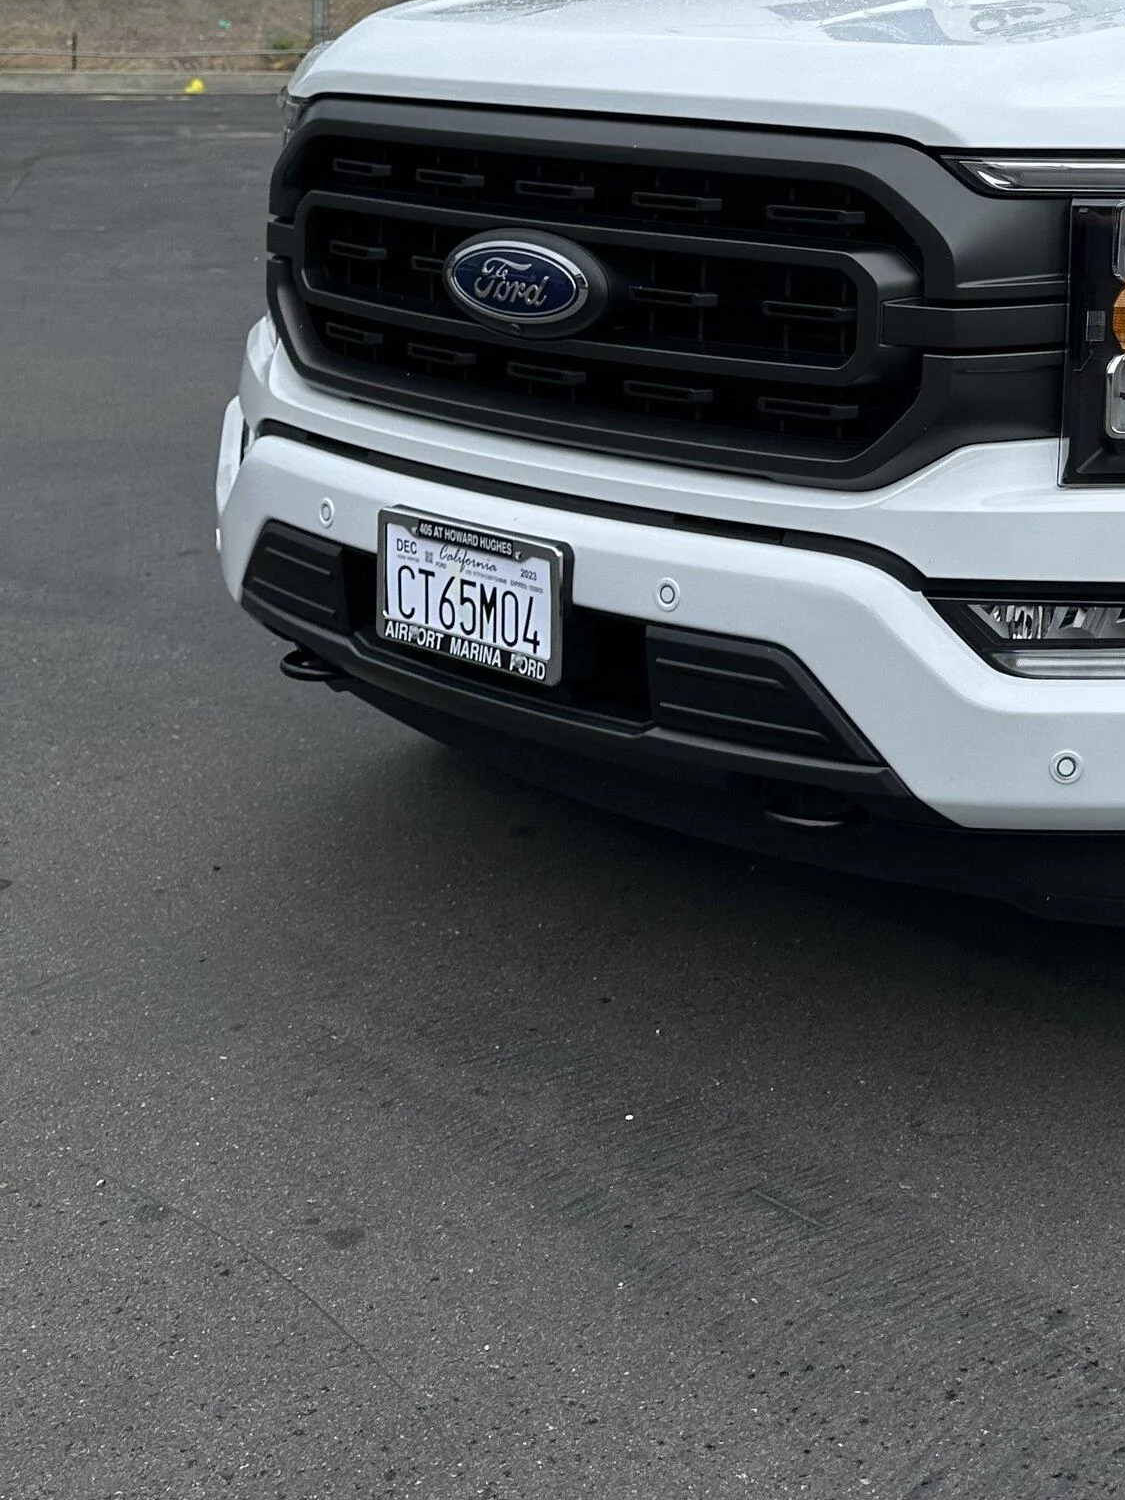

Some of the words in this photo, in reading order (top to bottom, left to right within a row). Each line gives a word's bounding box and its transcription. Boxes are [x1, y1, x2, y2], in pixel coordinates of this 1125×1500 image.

[474, 257, 550, 307] Ford
[396, 538, 418, 555] DEC
[433, 526, 444, 539] AT
[444, 528, 479, 547] HOWARD
[480, 536, 512, 556] HUGHES
[440, 544, 498, 573] California
[520, 568, 537, 581] 2023
[397, 564, 541, 654] CT65M04
[384, 620, 444, 650] AIRPORT
[450, 637, 501, 668] MARINA
[509, 653, 546, 681] FORD
